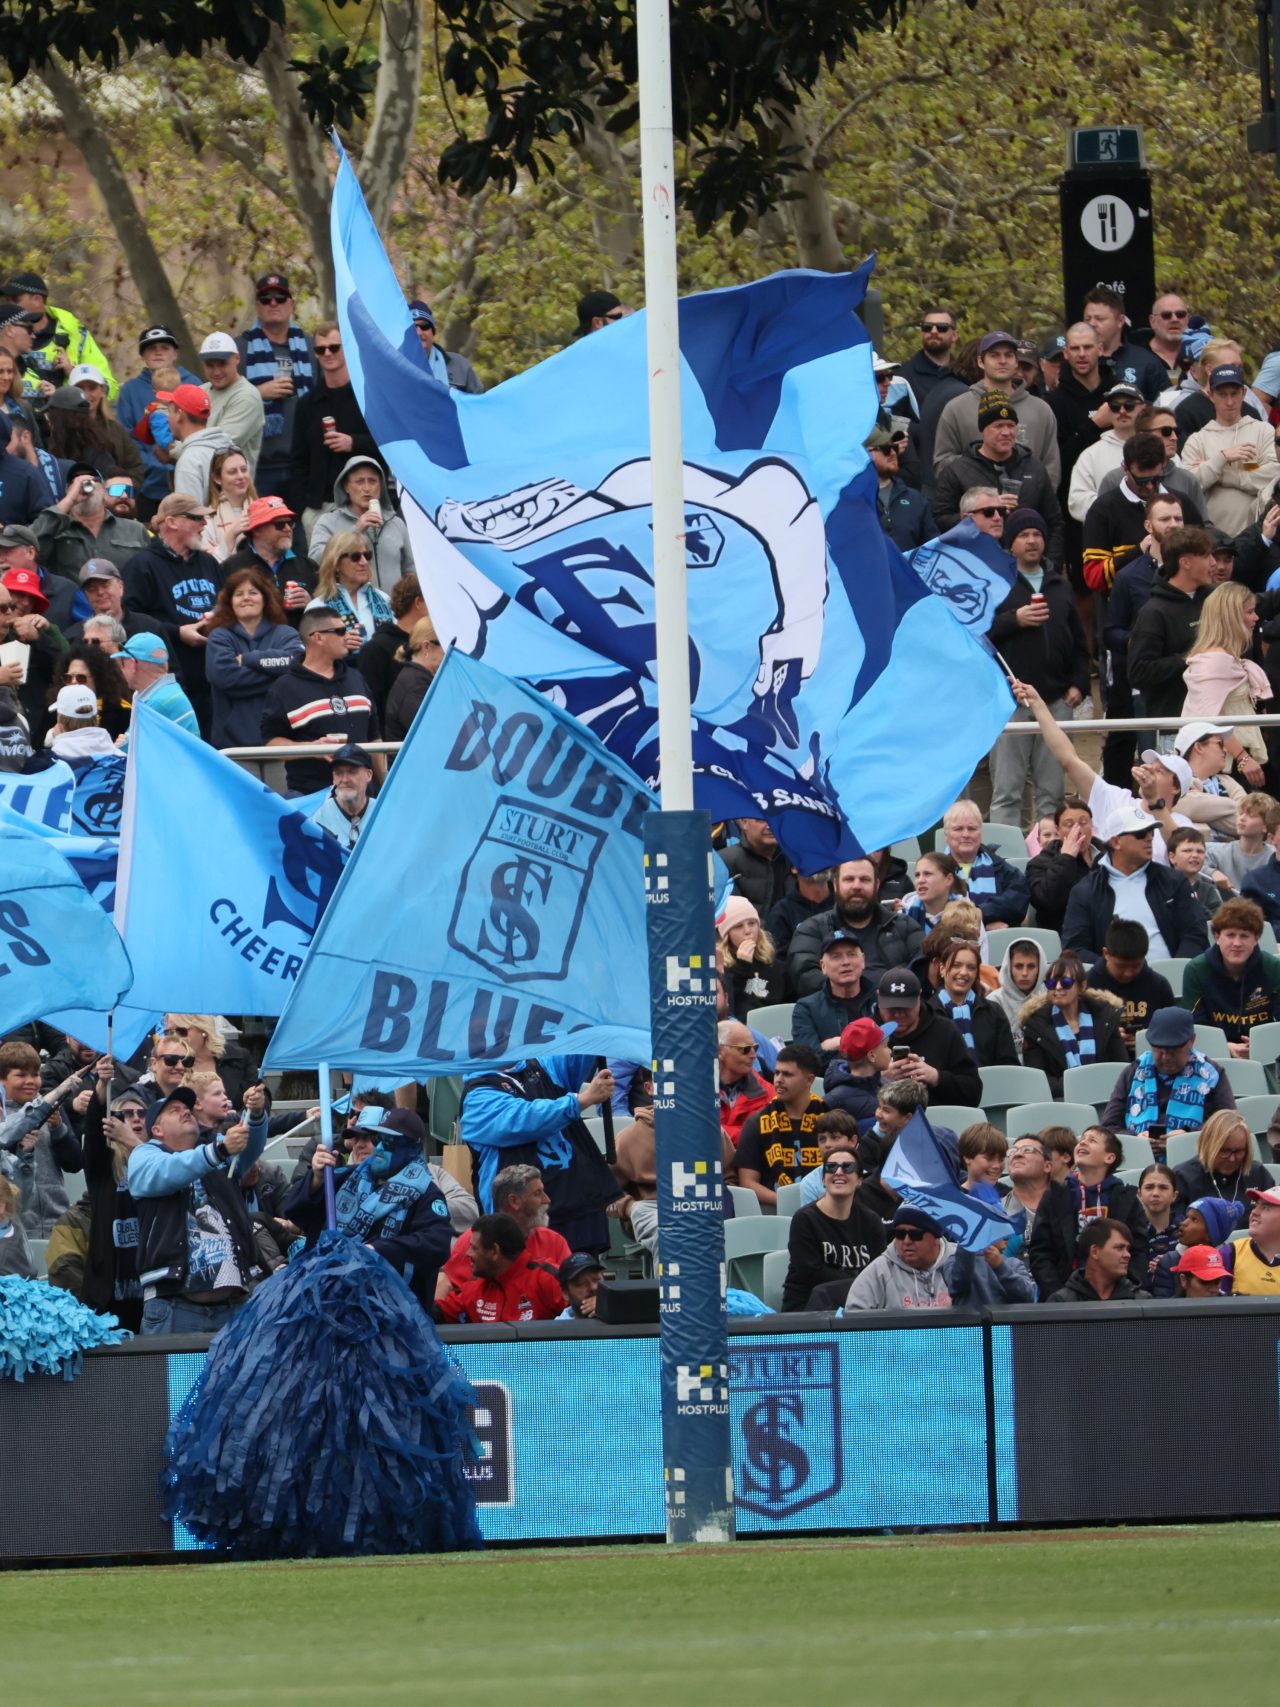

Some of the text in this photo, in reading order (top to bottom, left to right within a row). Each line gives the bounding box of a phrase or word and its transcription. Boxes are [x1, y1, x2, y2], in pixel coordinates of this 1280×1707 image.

[500, 808, 583, 855] STURT
[210, 898, 304, 982] CHEER
[1213, 1011, 1269, 1025] WWTFC
[673, 1201, 723, 1211] HOSTPLUS
[730, 1354, 820, 1379] STURT
[677, 1404, 729, 1415] HOSTPLUS
